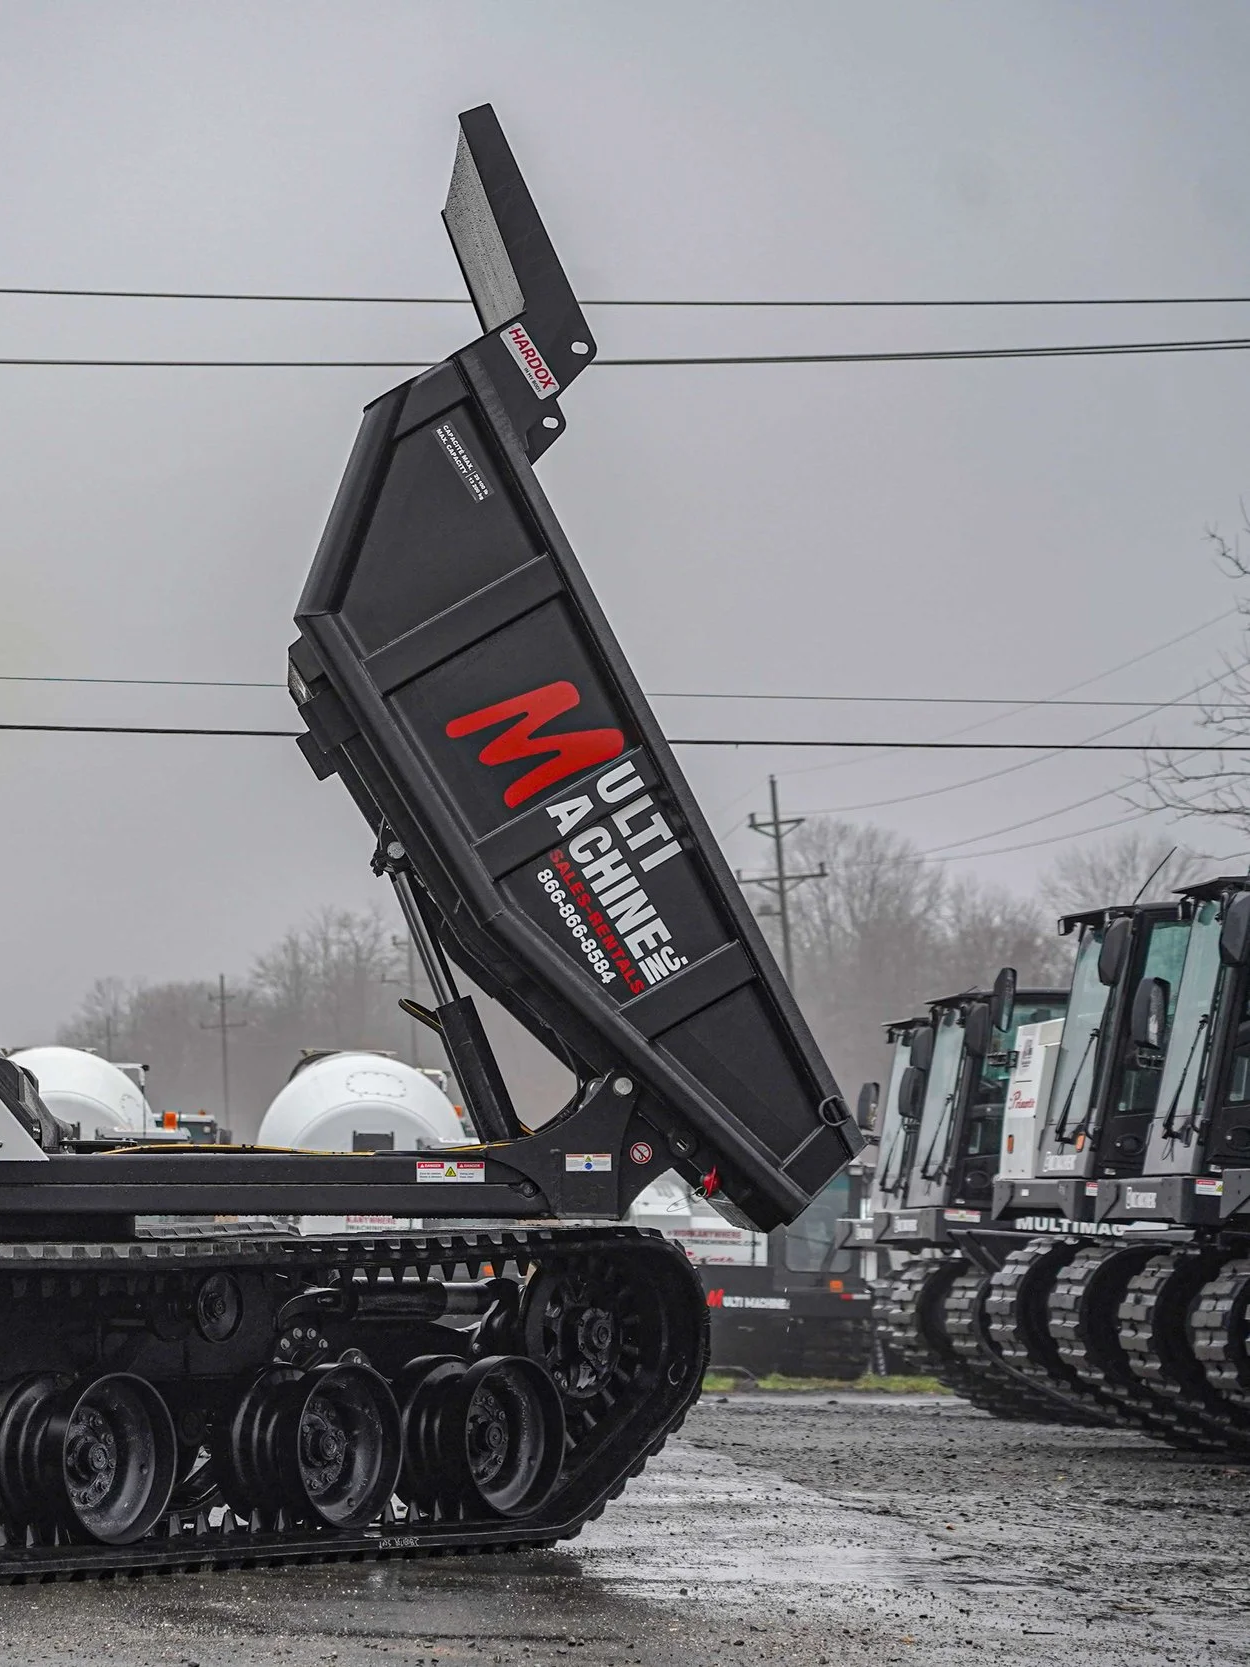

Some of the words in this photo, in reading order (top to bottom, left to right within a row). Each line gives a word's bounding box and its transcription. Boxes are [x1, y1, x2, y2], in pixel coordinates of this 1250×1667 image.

[509, 328, 556, 389] HARDOX
[436, 428, 447, 445] MAX.
[446, 444, 468, 474] CAPACITY
[443, 425, 465, 455] CAPACITÉ
[462, 455, 473, 471] MAX.
[537, 868, 617, 984] 866-866-8584
[549, 849, 645, 996] SALES-RENTALS
[640, 945, 688, 986] INC.
